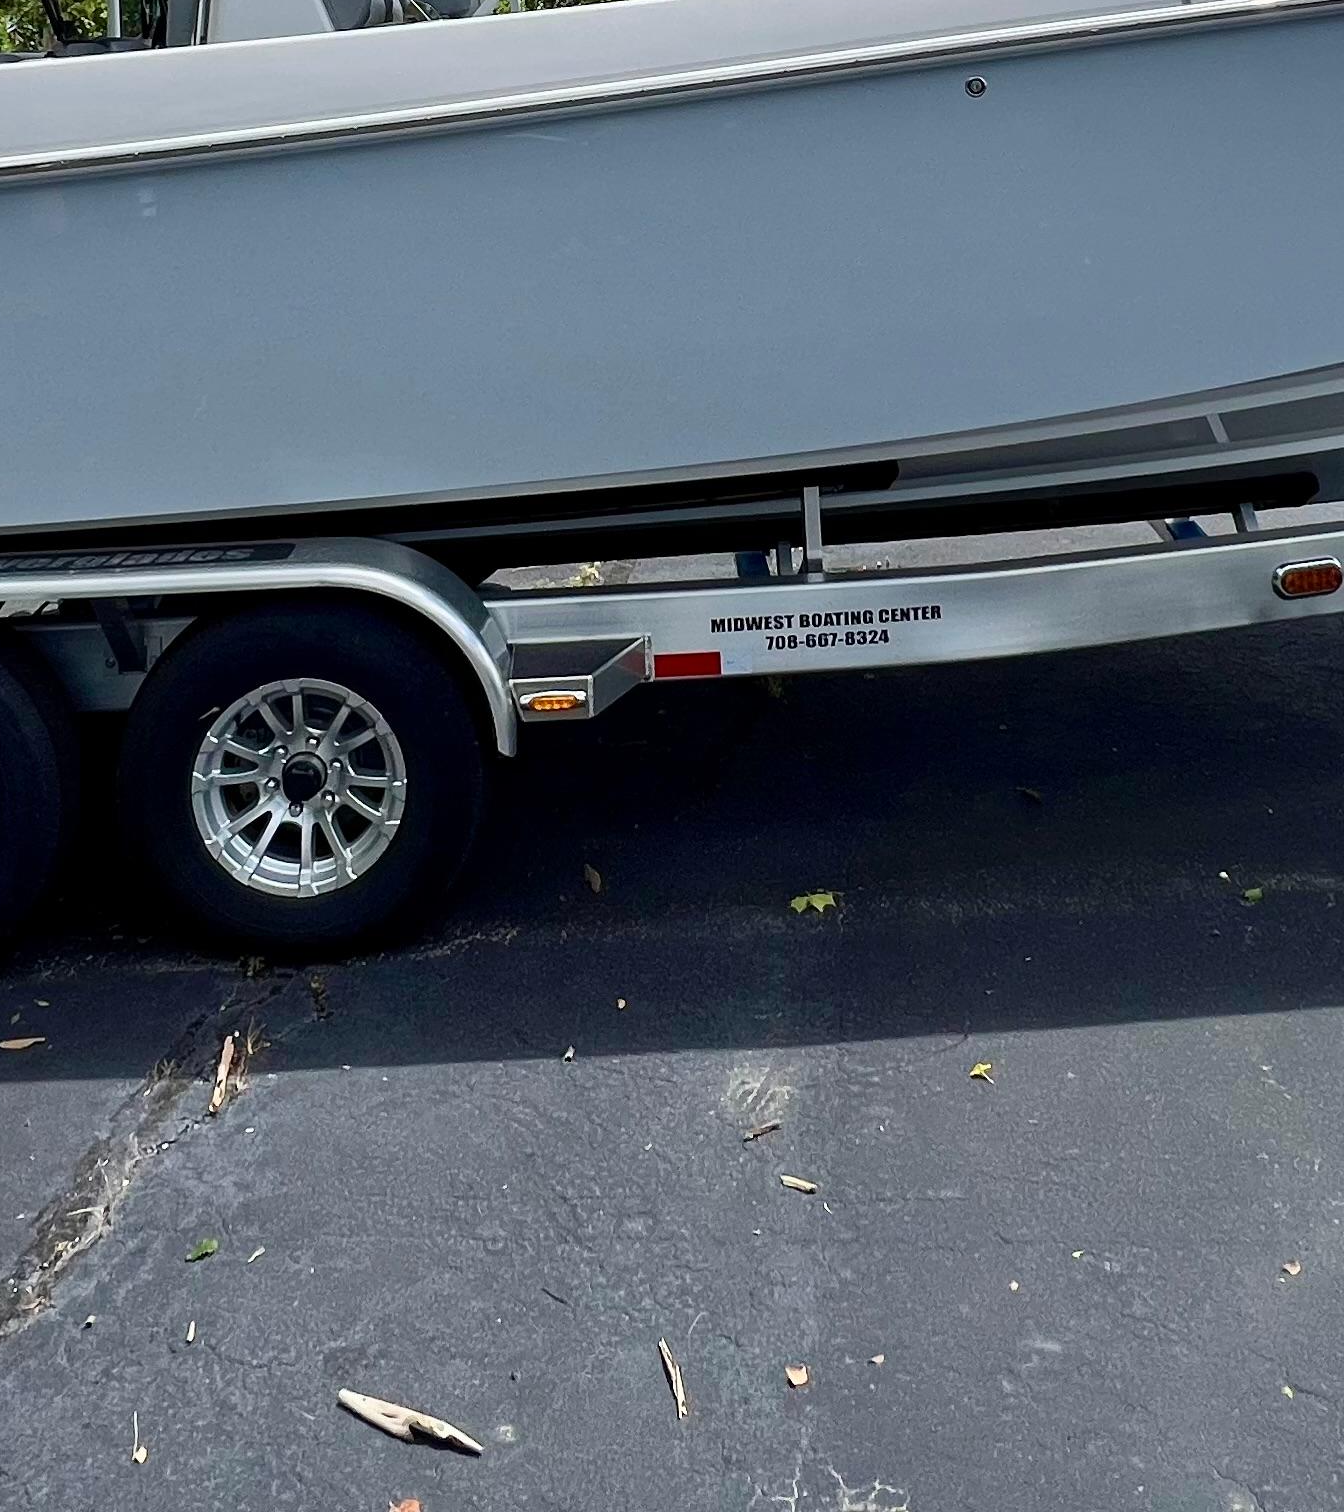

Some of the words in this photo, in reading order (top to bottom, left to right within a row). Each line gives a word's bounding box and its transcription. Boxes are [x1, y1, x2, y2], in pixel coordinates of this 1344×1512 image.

[710, 614, 795, 633] MIDWEST
[799, 609, 874, 628] BOATING
[878, 605, 942, 623] CENTER
[765, 629, 890, 651] 708-667-8324
